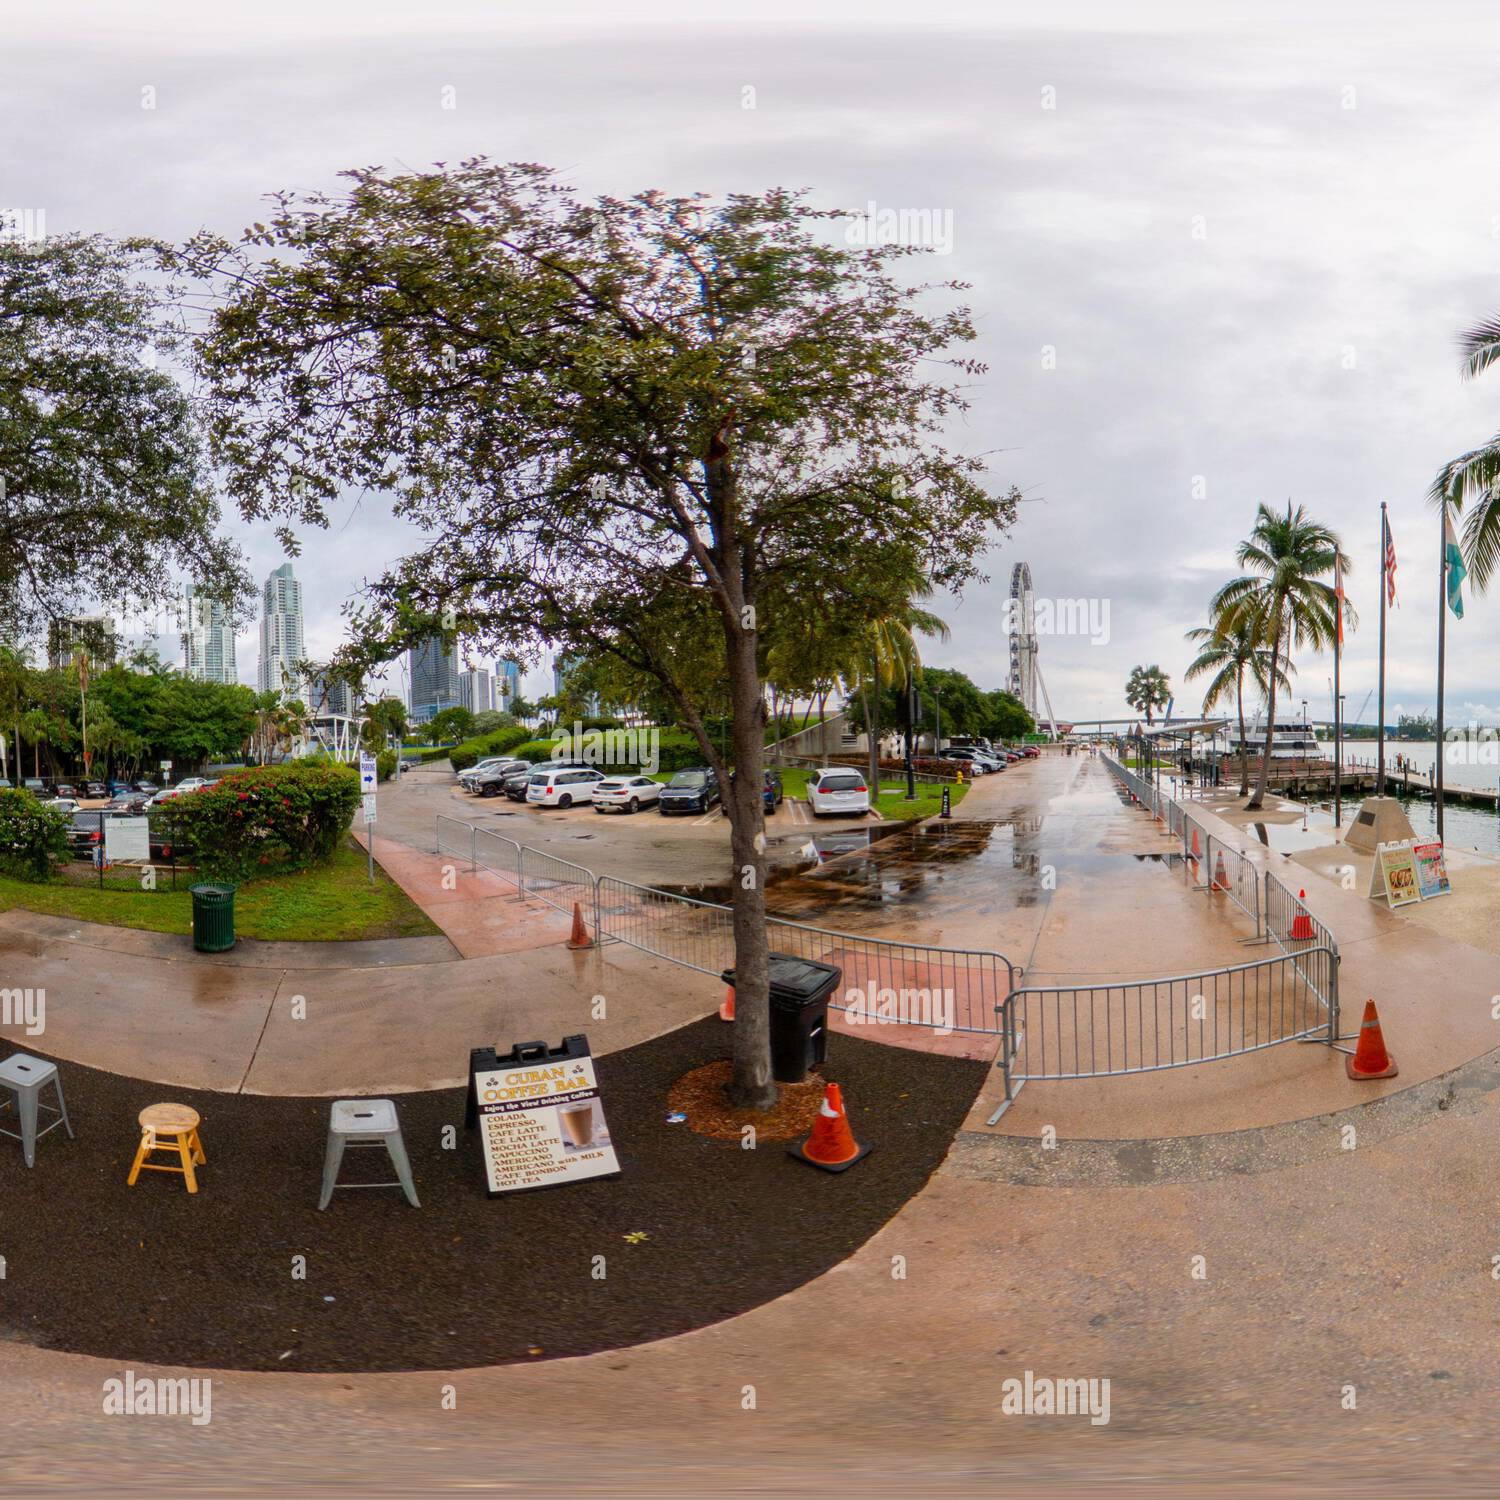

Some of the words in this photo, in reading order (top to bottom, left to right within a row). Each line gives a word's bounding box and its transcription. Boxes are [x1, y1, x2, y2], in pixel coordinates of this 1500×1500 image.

[505, 1066, 566, 1086] CUBAN
[483, 1083, 548, 1103] COFFEE
[554, 1076, 590, 1092] BAR
[484, 1105, 505, 1113] Enjoy
[541, 1095, 570, 1105] Drinking
[570, 1090, 594, 1100] Coffee
[487, 1113, 526, 1123] COLADA
[488, 1119, 537, 1131] ESPRESSO
[489, 1129, 515, 1138] CAFE
[518, 1125, 547, 1135] LATTE
[510, 1134, 540, 1142] LATTE
[491, 1143, 528, 1152] MOCHA
[531, 1138, 560, 1147] LATTE
[492, 1147, 549, 1160] CAPUCCINO
[494, 1154, 553, 1166] AMERICANO
[495, 1161, 554, 1173] AMERICANO
[558, 1157, 578, 1165] with
[581, 1151, 604, 1161] MILK
[495, 1172, 521, 1180] CAFE
[525, 1165, 567, 1176] BONBON
[522, 1176, 541, 1184] TEA
